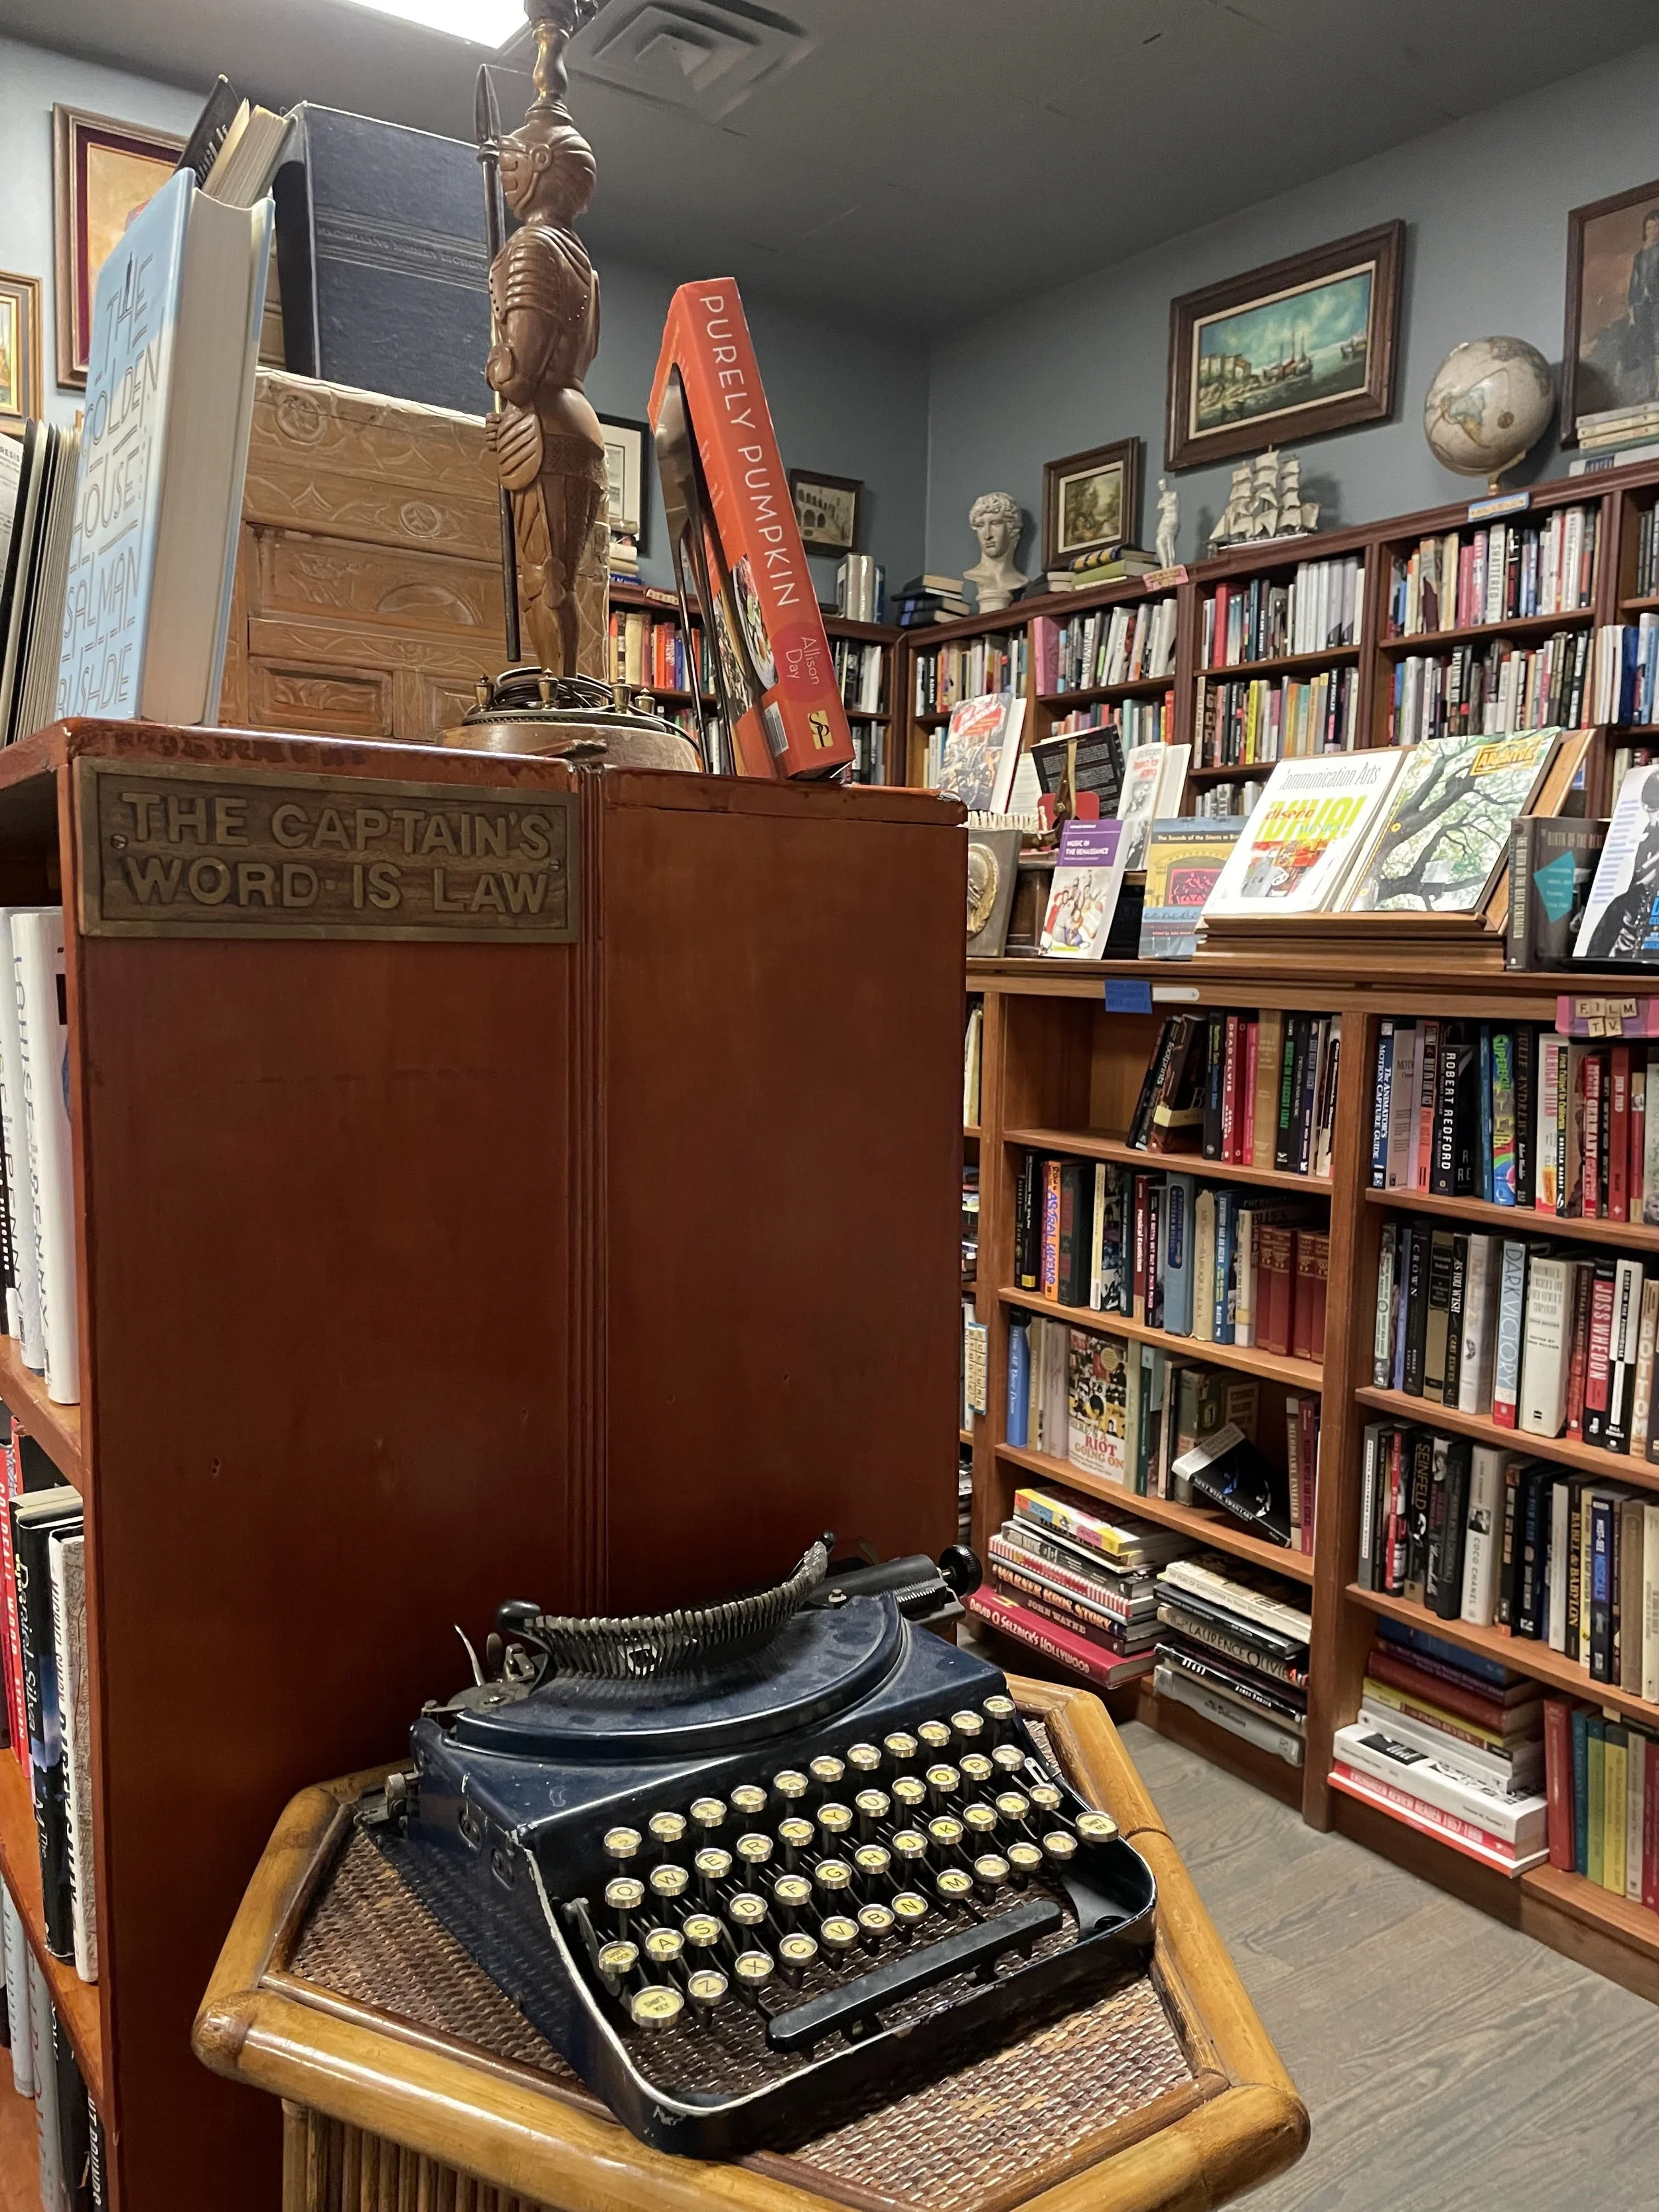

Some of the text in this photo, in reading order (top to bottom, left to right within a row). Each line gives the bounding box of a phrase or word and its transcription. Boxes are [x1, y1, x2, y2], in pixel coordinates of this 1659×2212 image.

[700, 293, 800, 608] PURELY PUMPKIN
[1489, 545, 1502, 598] SHATTERED
[785, 648, 802, 681] Day
[800, 636, 820, 687] Allison
[1354, 762, 1381, 785] Arts
[123, 792, 552, 861] THE CAPTAIN'S
[125, 856, 551, 915] WORD IS LAW
[1579, 1002, 1635, 1015] FILM
[1593, 1020, 1618, 1033] TV
[1157, 1041, 1175, 1085] footprints
[1517, 1032, 1528, 1137] JULIE ANDREWS
[1372, 1044, 1386, 1159] MOTION CAPTURE GUIDE
[1381, 1083, 1390, 1138] ANIMATOR'S
[1441, 1053, 1456, 1170] ROBERT REDFORD
[5, 1153, 24, 1303] PENNY
[1045, 1189, 1058, 1285] ASTRAL WEEKS
[1410, 1244, 1420, 1297] CROWN
[1451, 1258, 1463, 1313] AS YOU WISH
[1498, 1248, 1524, 1388] DARK VICTORY
[1589, 1284, 1613, 1380] JOSS WHEDON
[1074, 1442, 1124, 1469] GOING ON
[1085, 1436, 1118, 1457] RIOT
[1415, 1444, 1431, 1510] SEINFELD
[1570, 1511, 1581, 1552] BABEL
[1469, 1537, 1481, 1605] COCO CHANEL
[1593, 1554, 1606, 1601] MUSICALS
[997, 1565, 1043, 1598] WARNER
[1074, 1603, 1112, 1633] STORY
[1568, 1567, 1579, 1627] BABYLON
[1027, 1599, 1087, 1635] JOHN WAYNE
[970, 1597, 991, 1619] DAVID
[1001, 1616, 1039, 1647] SELZNICK'S
[1039, 1636, 1090, 1674] HOLLYWOOD
[1187, 1622, 1245, 1657] LAURENCE
[15, 1564, 38, 1732] Daniel Silva
[14, 1677, 25, 1739] STEVEN
[969, 1761, 983, 1770] P
[934, 1773, 950, 1783] O
[864, 1797, 880, 1807] U
[826, 1811, 840, 1821] Y
[973, 1812, 989, 1822] L
[786, 1825, 802, 1836] T
[938, 1823, 957, 1836] K
[40, 1832, 48, 1858] The
[745, 1841, 765, 1852] R
[904, 1838, 916, 1849] J
[704, 1855, 721, 1866] E
[863, 1852, 882, 1864] H
[658, 1873, 677, 1885] W
[825, 1868, 842, 1878] G
[946, 1877, 968, 1889] M
[616, 1887, 632, 1897] Q
[785, 1883, 802, 1894] F
[740, 1902, 758, 1913] D
[902, 1900, 921, 1913] N
[693, 1923, 711, 1935] S
[830, 1924, 846, 1936] V
[867, 1913, 885, 1925] B
[658, 1938, 675, 1950] A
[789, 1943, 806, 1954] C
[613, 1953, 630, 1962] LOCK
[746, 1960, 765, 1974] X
[697, 1978, 719, 1992] Z
[644, 1996, 664, 2008] SHIFT
[654, 2002, 670, 2013] KEY
